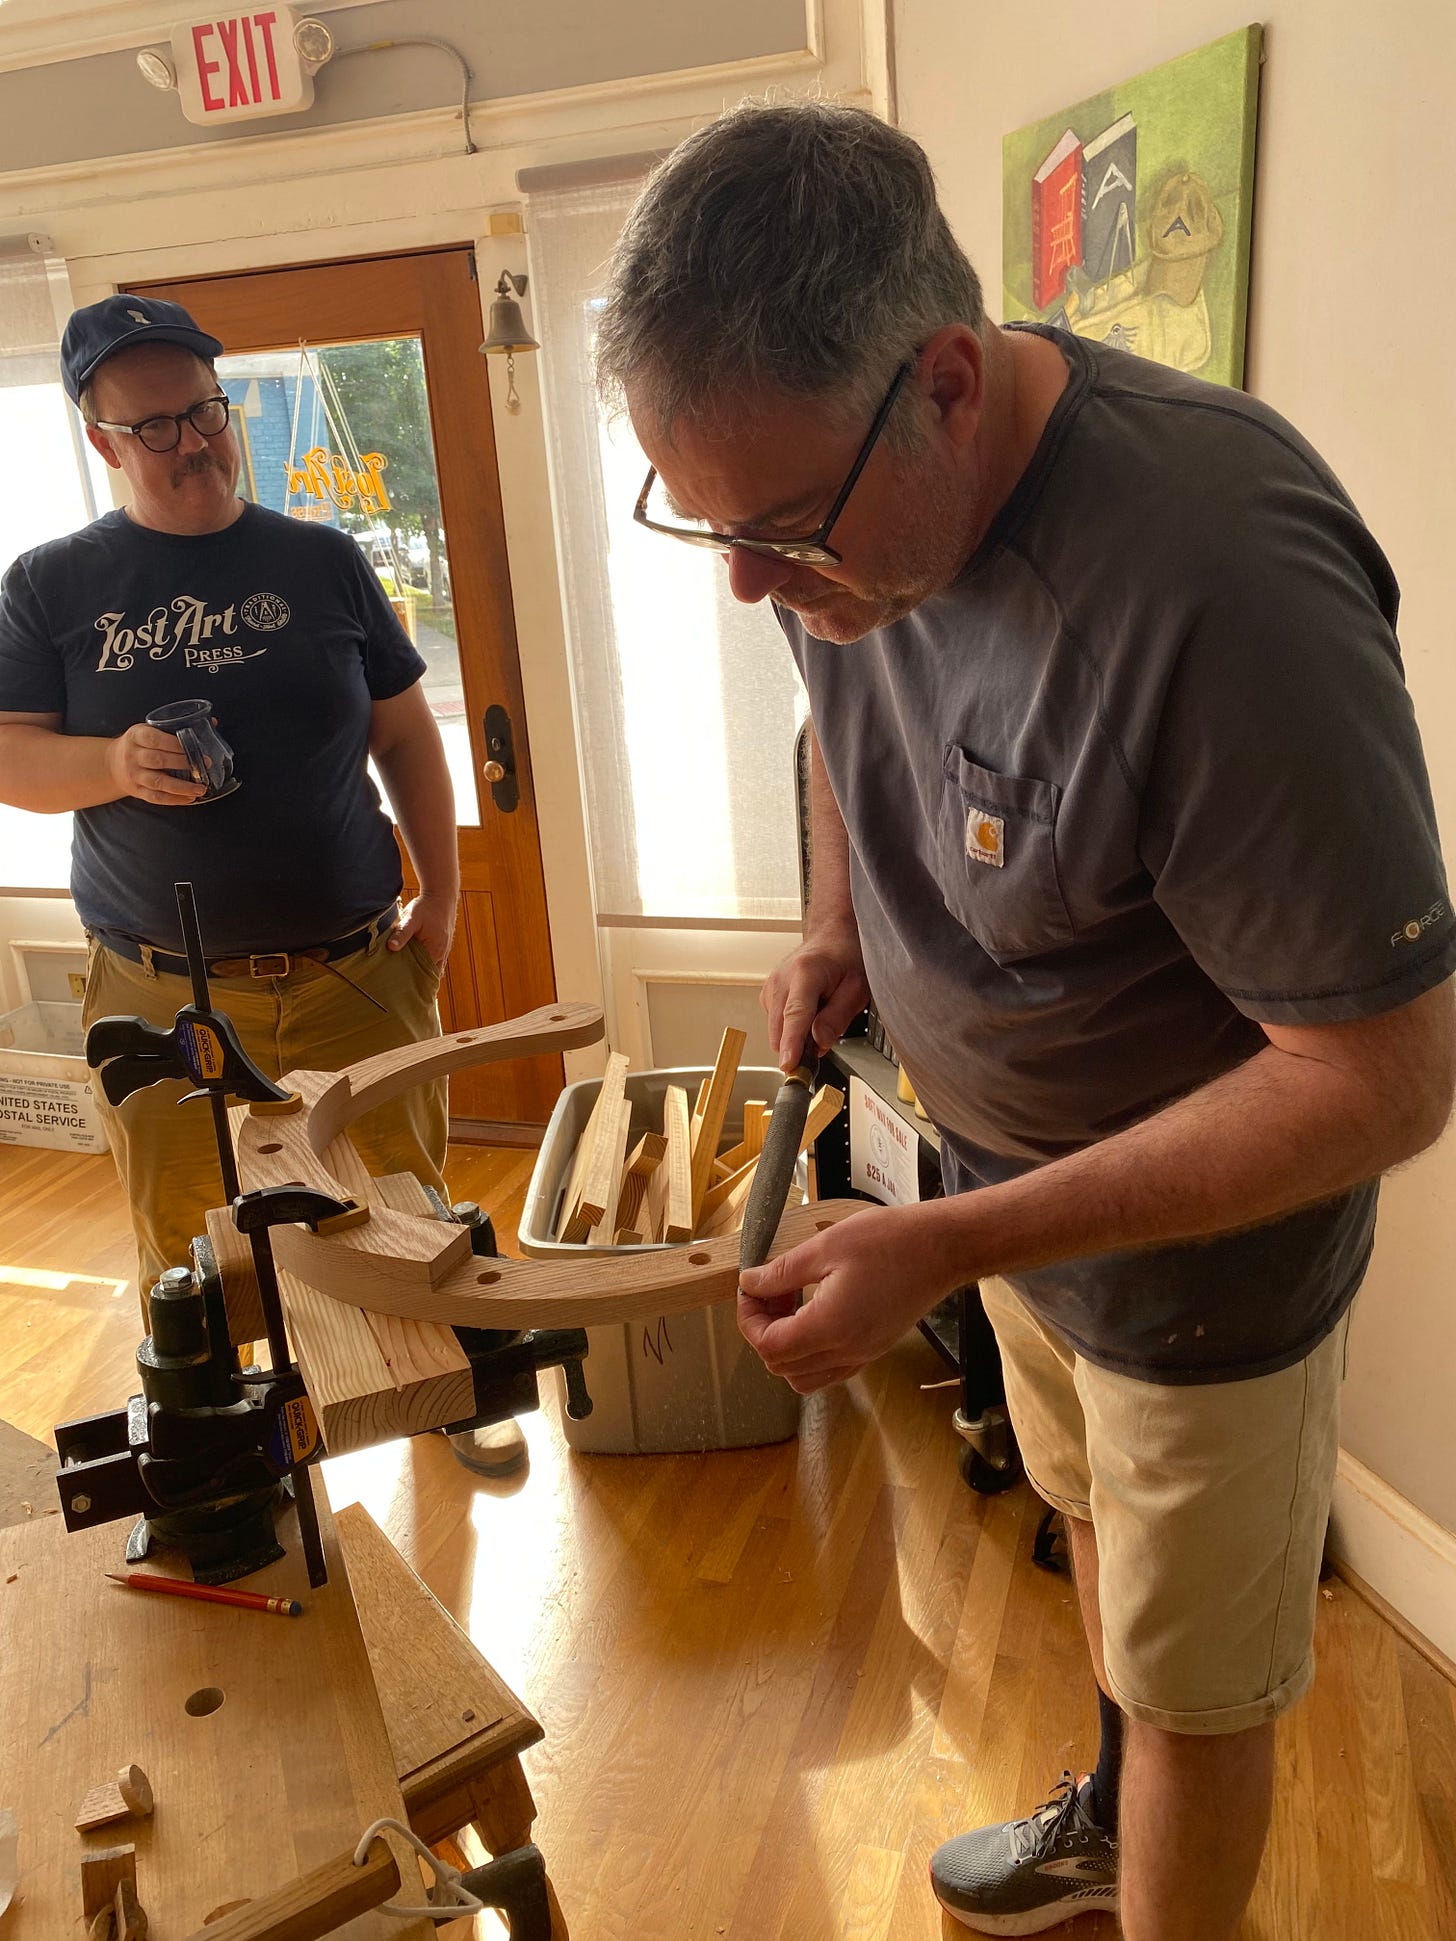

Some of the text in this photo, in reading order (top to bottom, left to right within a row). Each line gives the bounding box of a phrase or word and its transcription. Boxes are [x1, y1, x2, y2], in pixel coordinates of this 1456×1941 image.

[192, 11, 281, 111] EXIT
[94, 595, 238, 672] Lost Art
[1391, 899, 1446, 947] FORCE
[0, 1096, 78, 1114] NITED STATES
[0, 1110, 86, 1128] OSTAL SERVICE
[866, 1162, 881, 1182] $25
